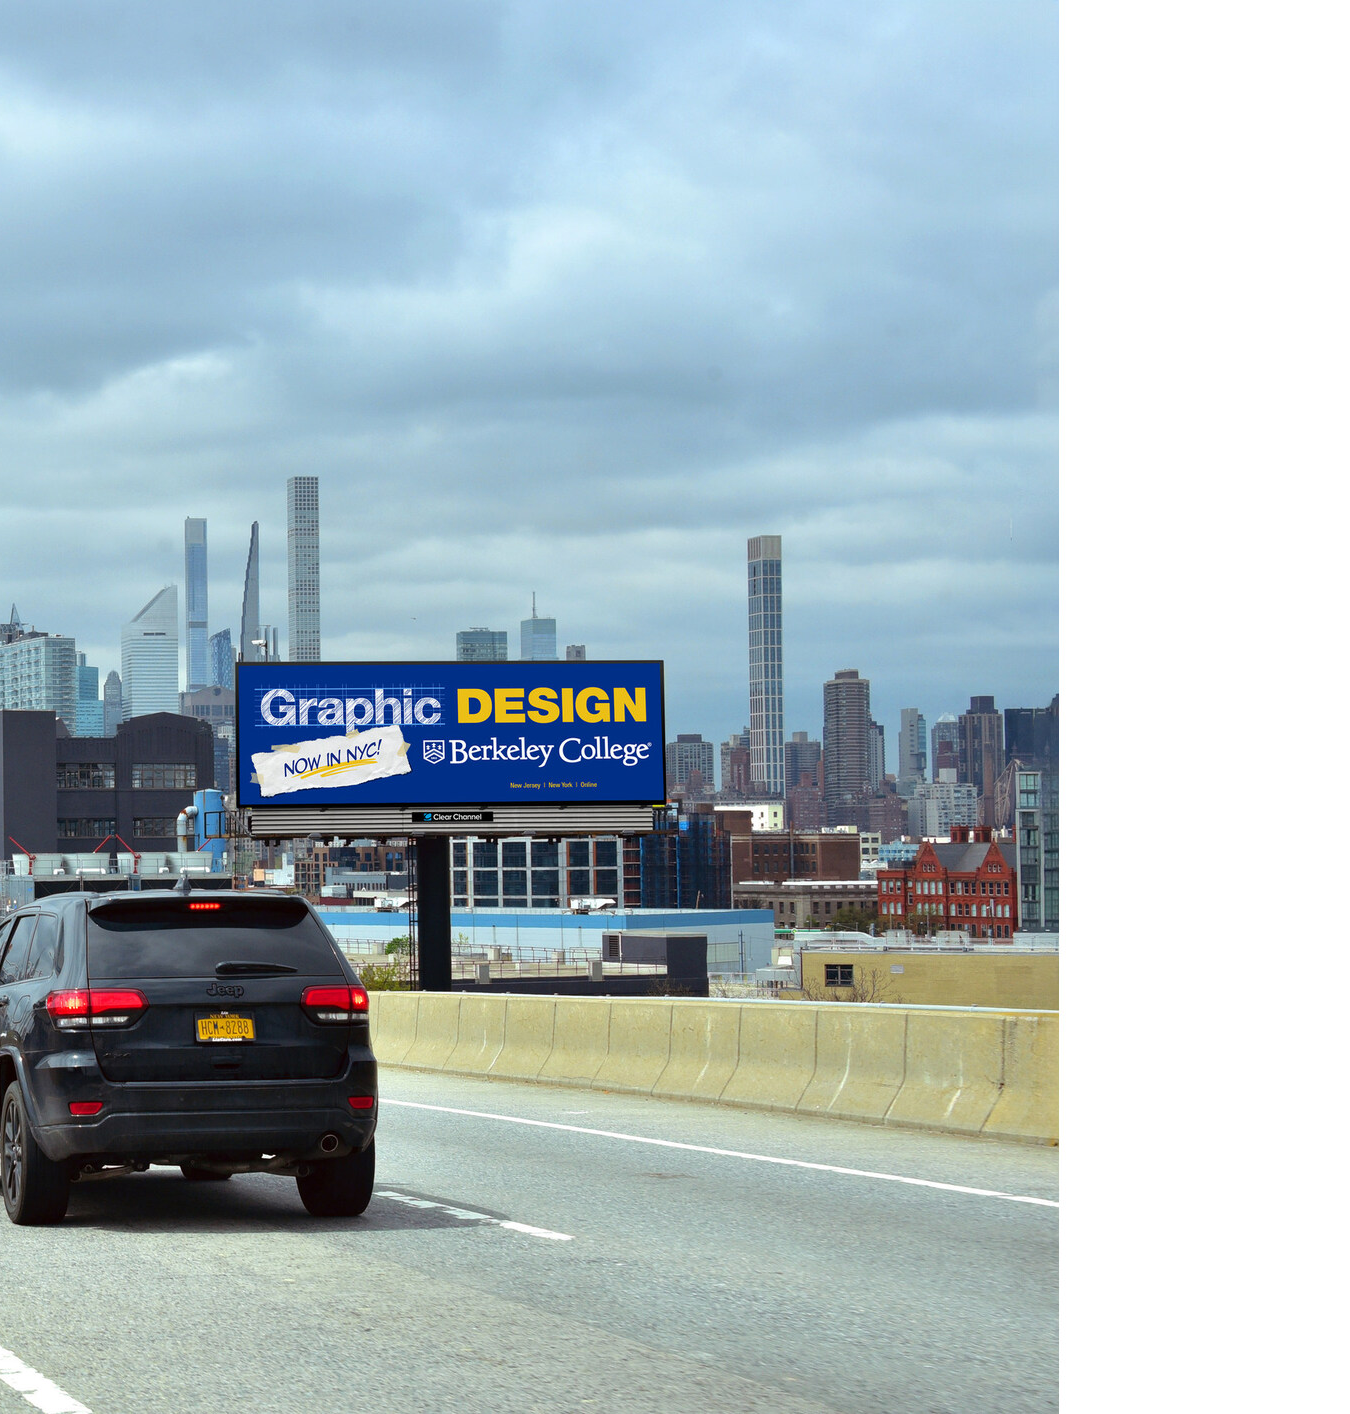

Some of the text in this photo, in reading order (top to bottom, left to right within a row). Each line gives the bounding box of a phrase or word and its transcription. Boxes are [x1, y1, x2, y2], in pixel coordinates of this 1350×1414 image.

[260, 686, 647, 734] Graphic DESIGN
[283, 739, 382, 777] NOW IN NYC!
[449, 737, 554, 768] Berkeley
[433, 813, 482, 821] Clear Channel
[206, 983, 244, 998] Jeep
